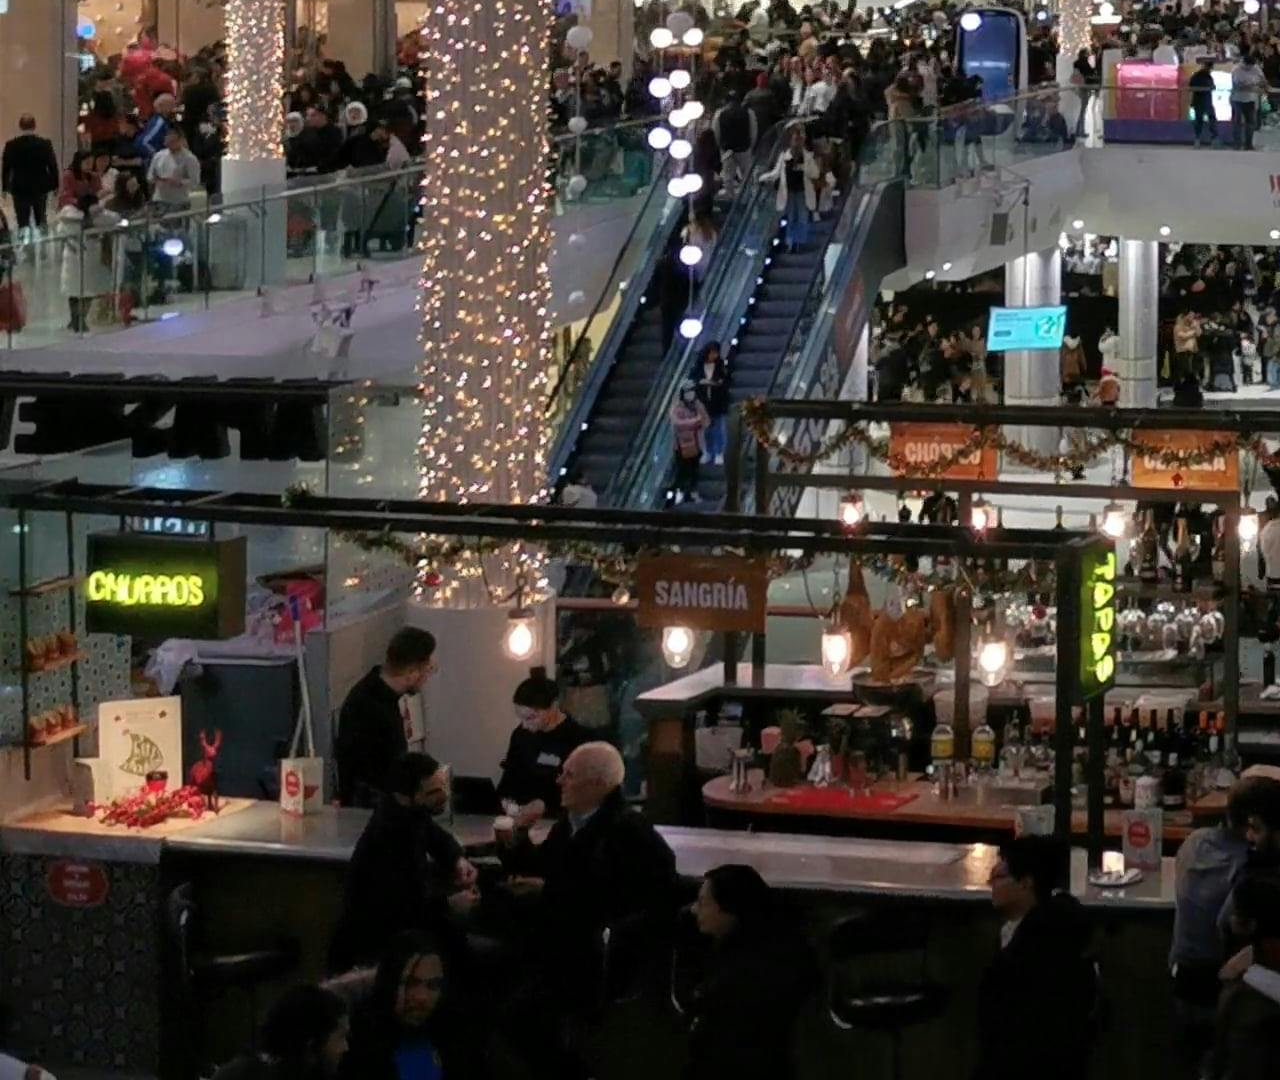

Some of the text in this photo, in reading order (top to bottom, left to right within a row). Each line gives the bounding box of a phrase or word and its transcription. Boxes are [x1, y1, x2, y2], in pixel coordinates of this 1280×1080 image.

[88, 571, 204, 606] CHURROS
[655, 576, 749, 610] SANGRÍA
[1092, 552, 1115, 683] TAPAS
